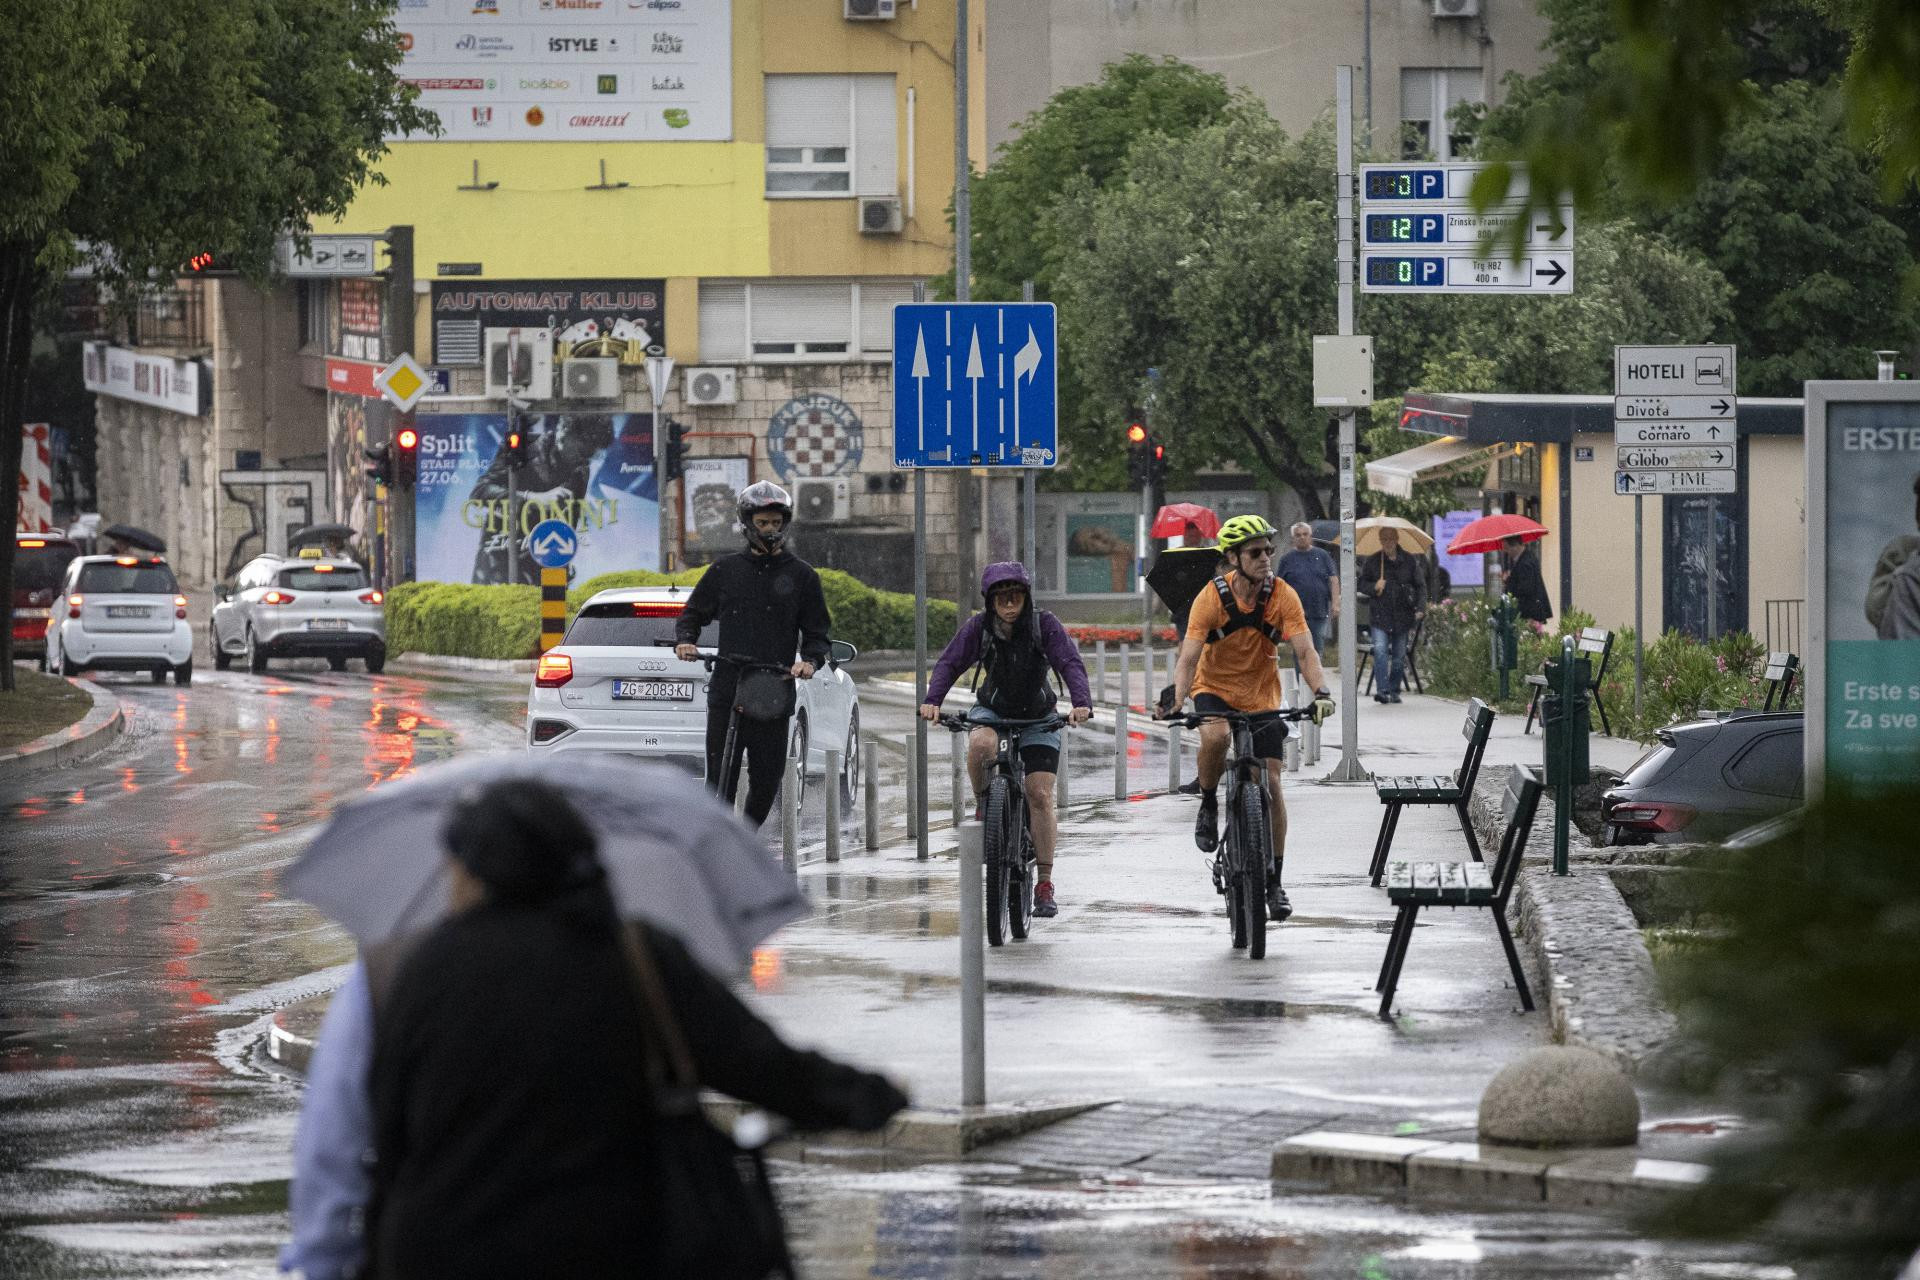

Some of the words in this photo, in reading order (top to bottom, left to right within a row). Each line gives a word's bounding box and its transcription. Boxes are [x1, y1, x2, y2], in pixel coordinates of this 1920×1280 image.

[549, 38, 598, 52] iSTYLE
[569, 112, 631, 127] CINEPLEXX
[1422, 175, 1436, 195] P
[1391, 218, 1411, 238] 12
[1422, 218, 1437, 238] P
[1399, 261, 1412, 282] 0
[1423, 261, 1437, 281] P
[1475, 273, 1490, 283] 400
[436, 291, 573, 311] AUTOMAT
[580, 291, 657, 310] KLUB
[1628, 364, 1684, 379] HOTELI
[1626, 405, 1669, 416] Divota
[1638, 430, 1691, 441] Cornaro
[1843, 426, 1920, 451] ERSTE
[421, 434, 475, 458] Split
[420, 459, 456, 470] STARI
[1626, 453, 1669, 467] Globo
[420, 471, 463, 484] 27.06.
[621, 682, 637, 695] ZG
[1844, 681, 1902, 700] Erste
[1845, 709, 1873, 728] Za
